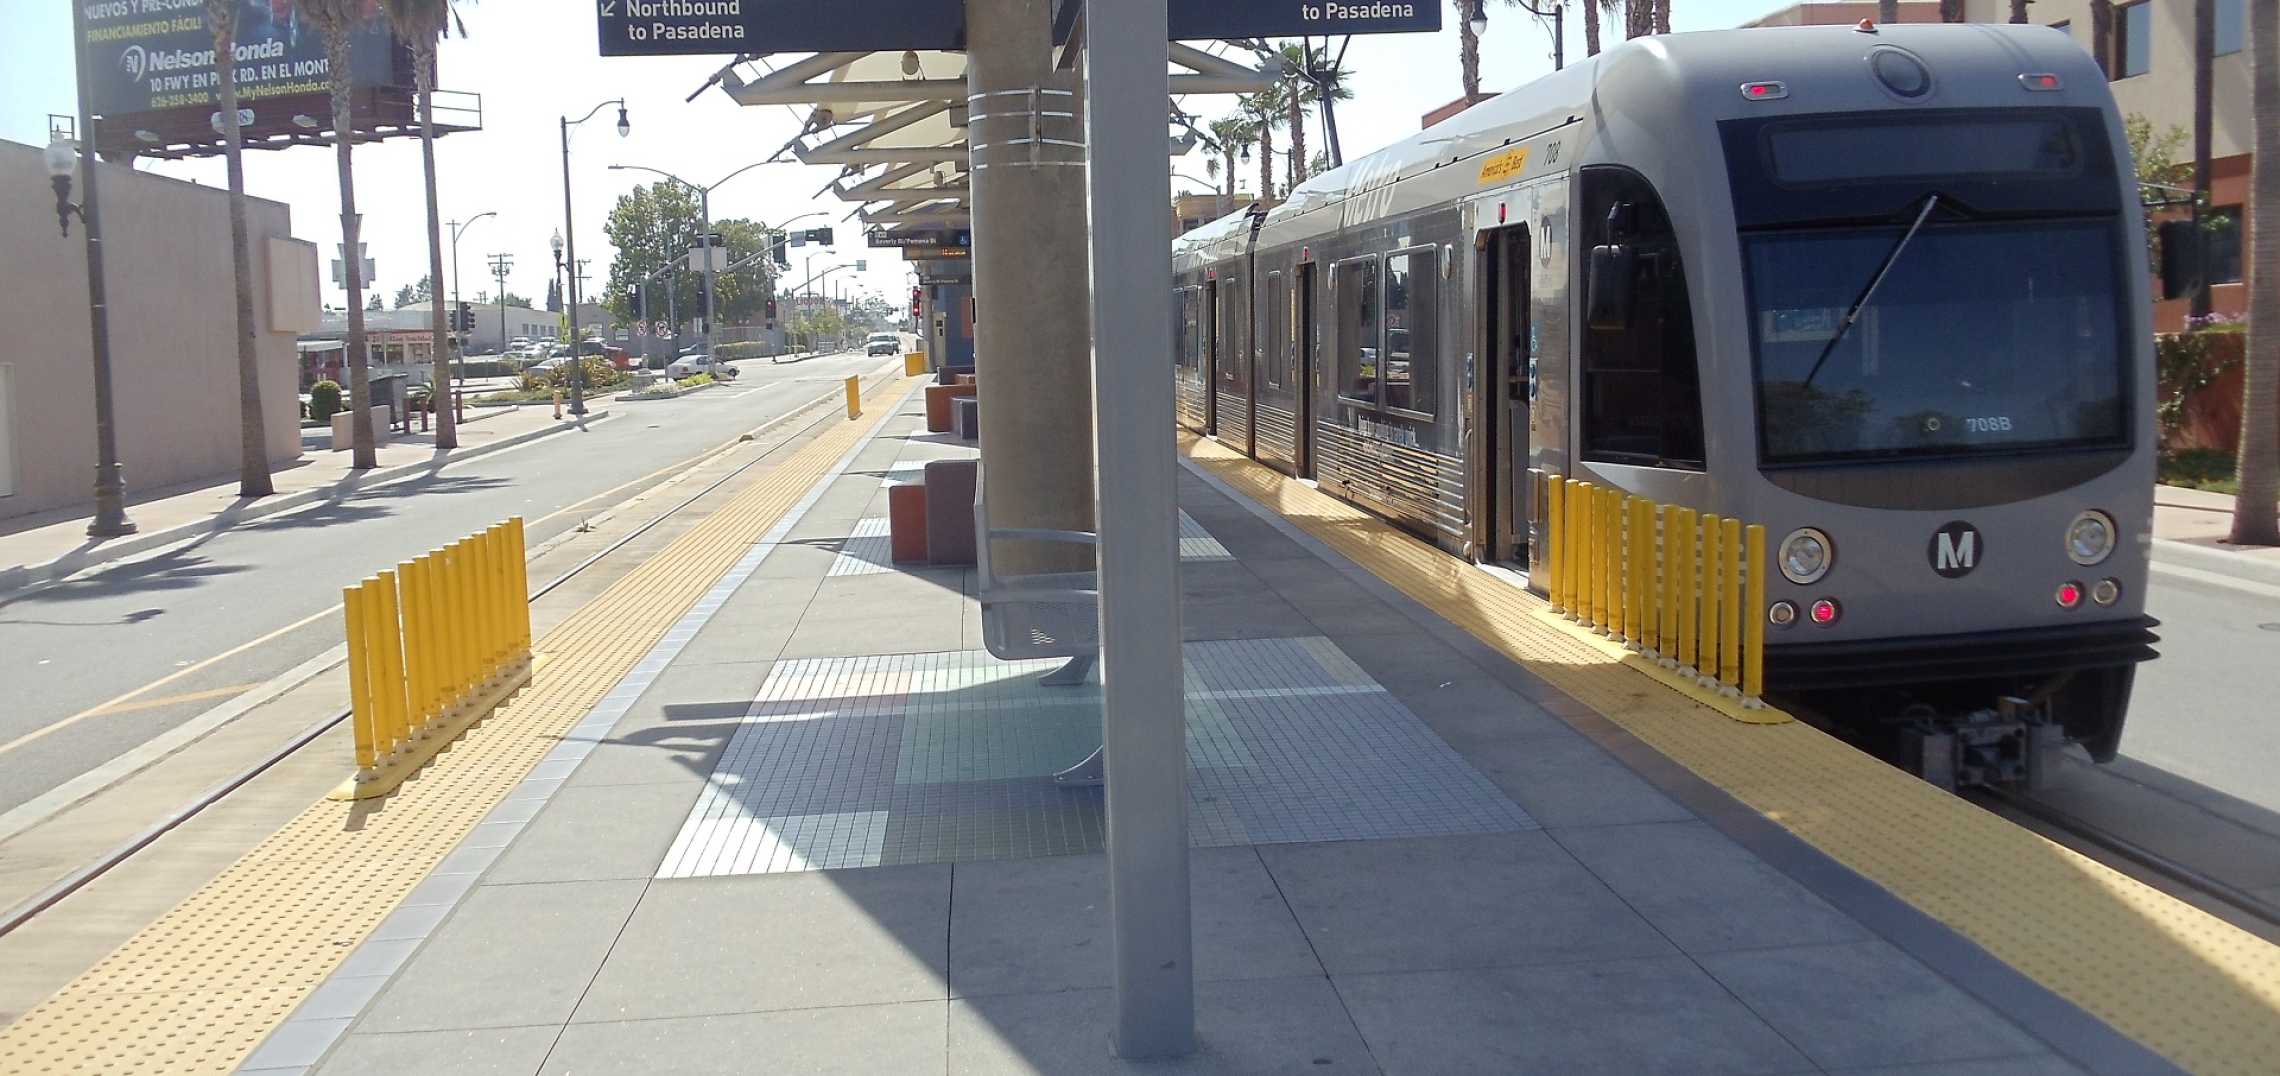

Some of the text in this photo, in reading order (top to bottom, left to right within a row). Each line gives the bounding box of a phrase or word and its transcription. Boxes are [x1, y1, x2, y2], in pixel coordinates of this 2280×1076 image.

[626, 0, 740, 17] Northbound
[1302, 2, 1414, 20] to Pasadena
[88, 21, 169, 42] FINANCIAMIENTO
[628, 22, 745, 40] to Pasadena
[150, 49, 215, 71] Nelson
[150, 78, 161, 92] 10
[164, 75, 190, 90] FWY
[193, 72, 208, 88] EN
[240, 67, 259, 83] RD.
[261, 64, 277, 80] EN
[280, 62, 292, 78] EL
[294, 58, 329, 77] MONT
[1543, 141, 1561, 166] 708
[1966, 416, 2012, 433] 708B
[1937, 531, 1974, 570] M
